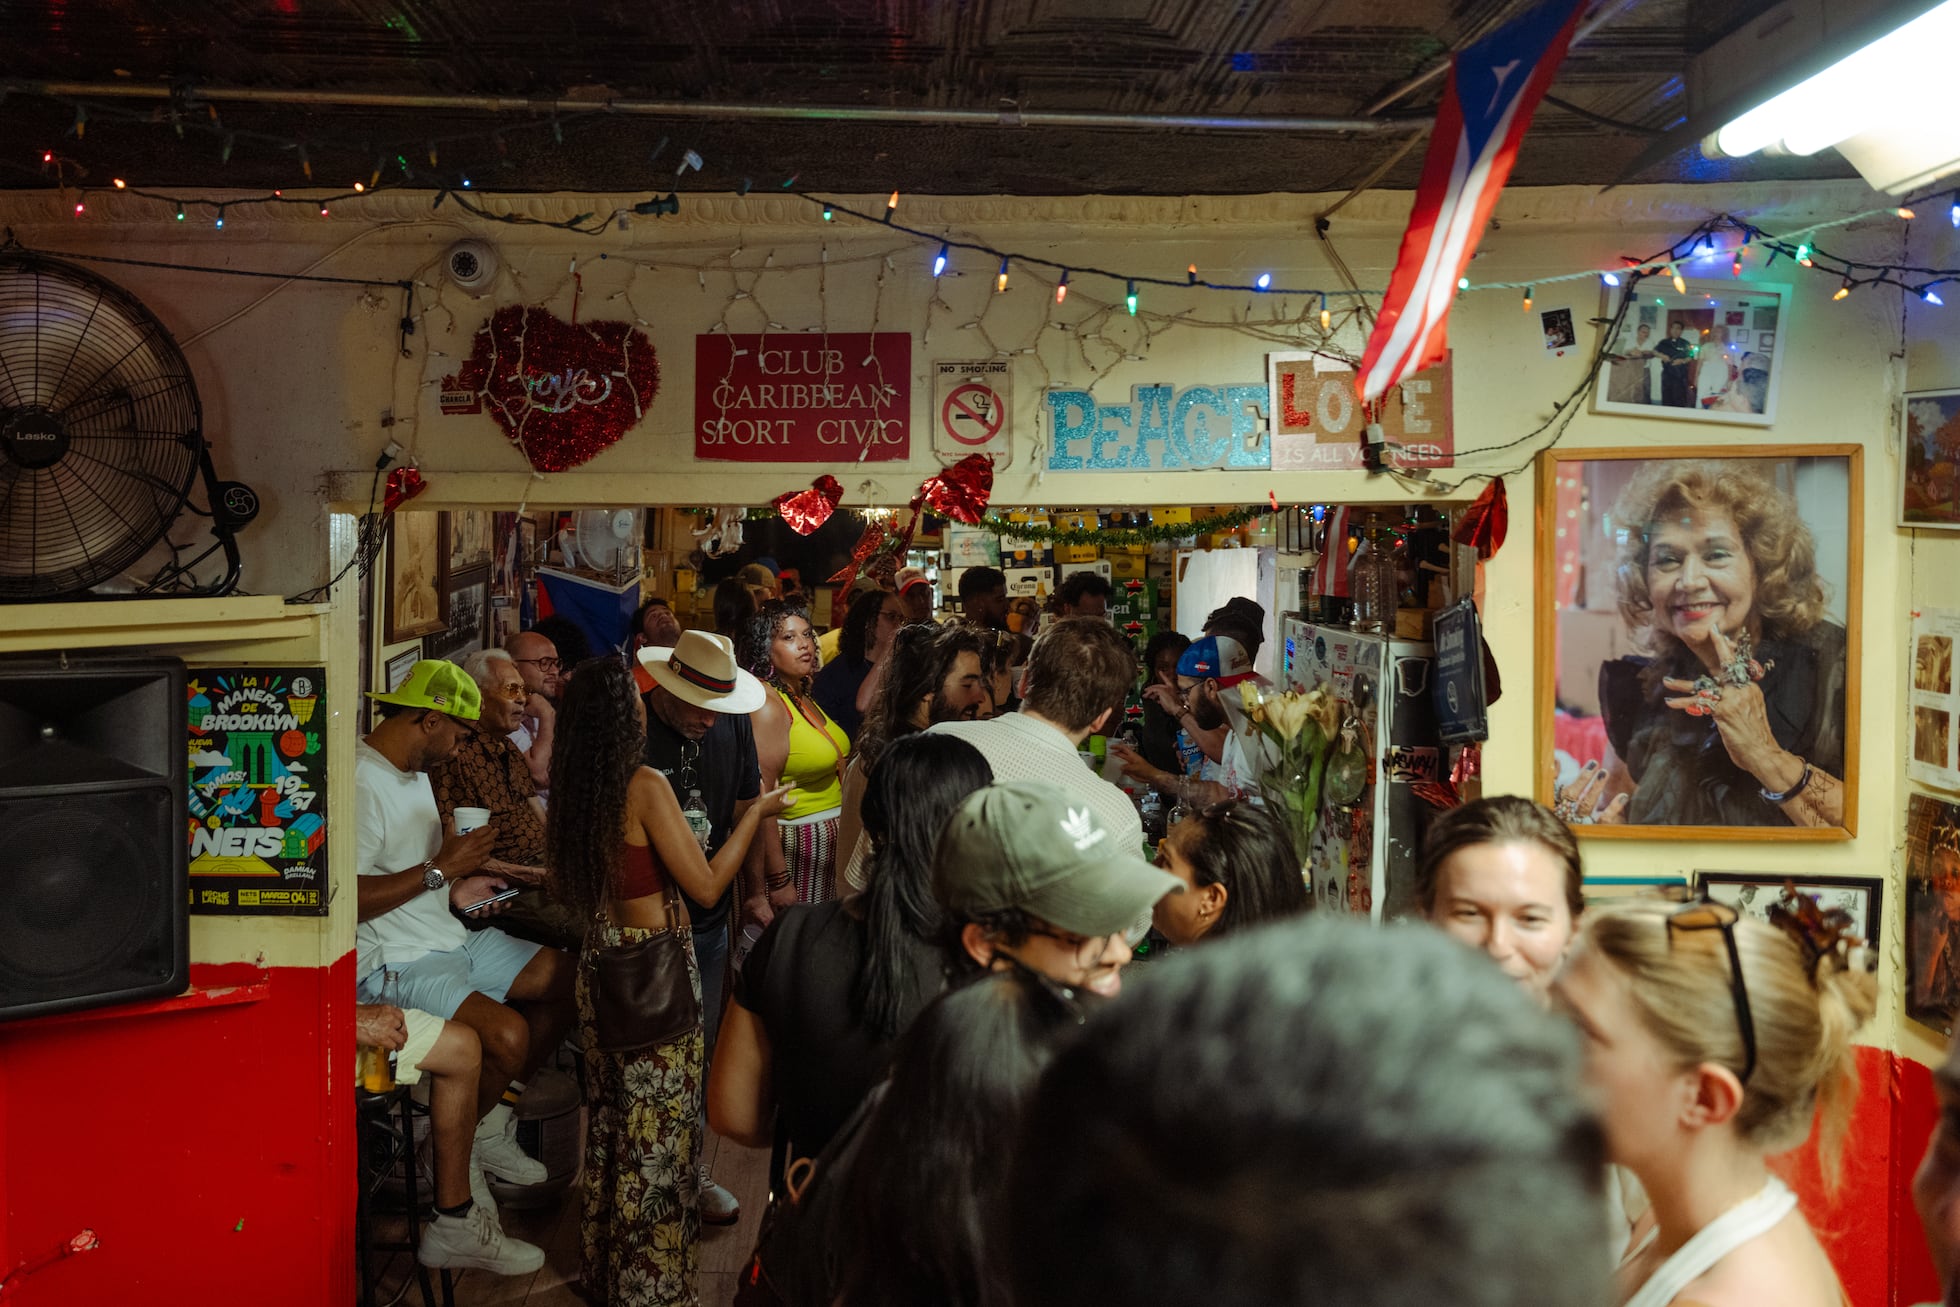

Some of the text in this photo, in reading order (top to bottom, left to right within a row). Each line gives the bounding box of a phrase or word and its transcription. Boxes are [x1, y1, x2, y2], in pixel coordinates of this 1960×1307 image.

[764, 349, 844, 374] CLUB
[712, 384, 893, 410] CARIBBEAN
[1282, 373, 1432, 434] LOE
[16, 431, 56, 441] Lasko
[702, 419, 904, 446] SPORT CIVIC
[1047, 386, 1270, 469] PEACE
[1284, 449, 1305, 463] IS
[1310, 447, 1342, 463] ALL
[1391, 444, 1443, 462] NEED
[1010, 583, 1036, 591] Corona
[242, 676, 257, 688] LA
[217, 687, 285, 714] MANERA
[241, 702, 258, 713] DE
[200, 714, 299, 732] BROOKLYN
[201, 770, 247, 798] VAMOS!
[275, 775, 301, 794] 19
[290, 790, 316, 811] 67
[190, 826, 285, 858] NETS
[283, 866, 316, 876] DAMIAN
[291, 892, 306, 904] 04
